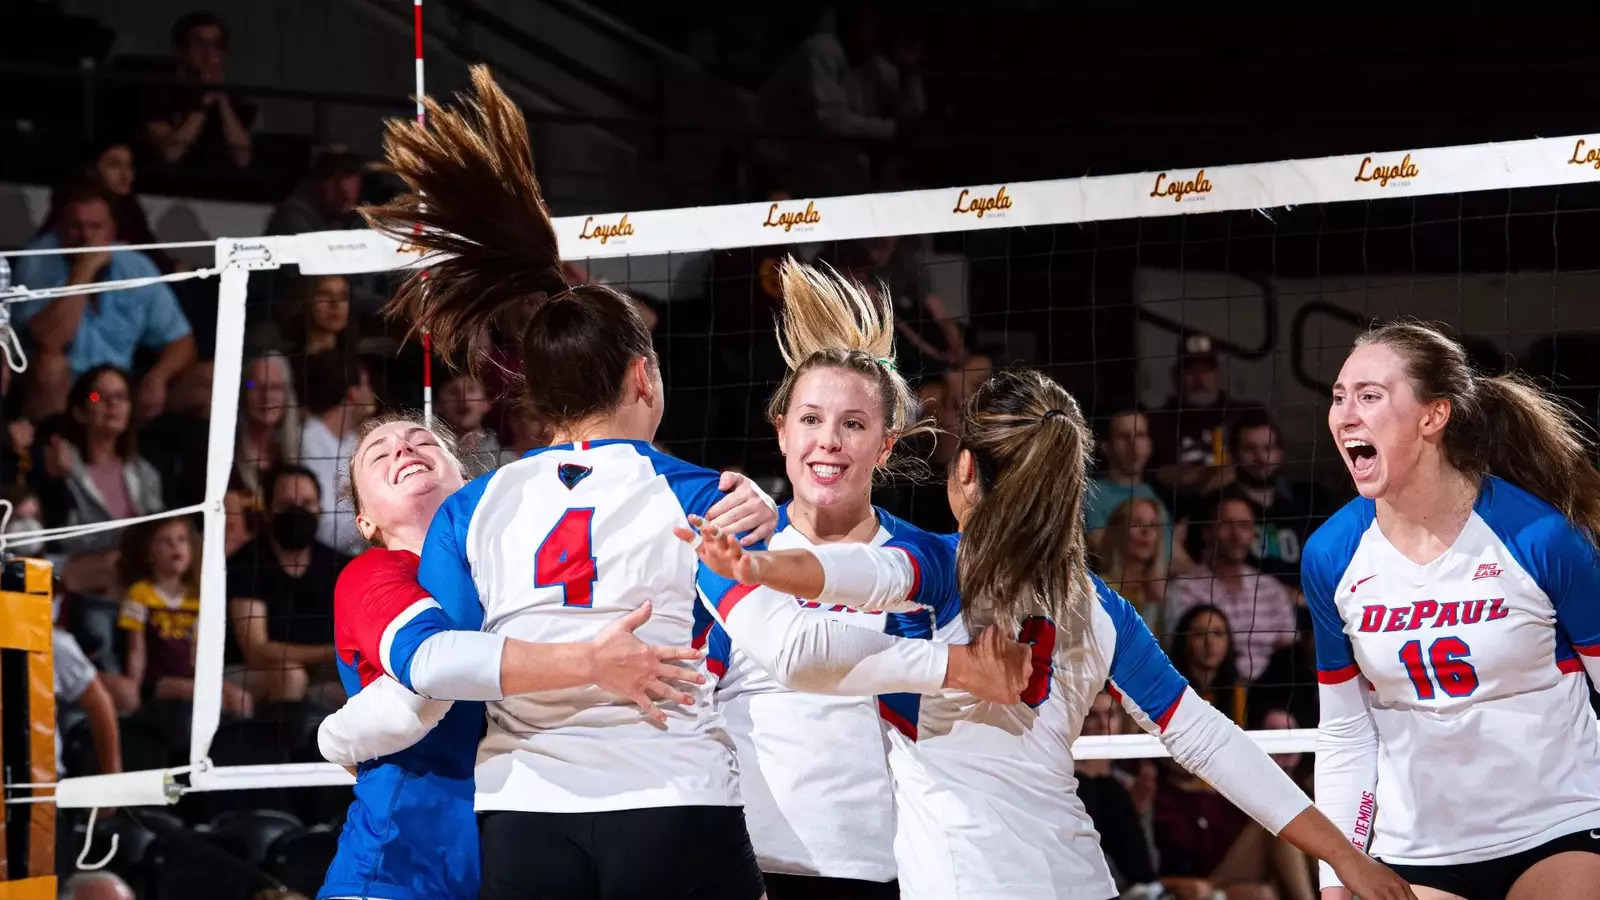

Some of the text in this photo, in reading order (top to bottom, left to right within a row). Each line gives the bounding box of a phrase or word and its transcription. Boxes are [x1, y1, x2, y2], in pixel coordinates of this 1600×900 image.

[1150, 169, 1212, 202] Loyola
[1354, 153, 1419, 188] Loyola
[763, 200, 820, 232] Loyola
[953, 186, 1012, 218] Loyola
[579, 213, 634, 244] Loyola
[534, 506, 598, 608] 4
[1477, 562, 1498, 571] BIG
[1474, 569, 1504, 578] EAST
[1398, 635, 1480, 701] 16
[1354, 790, 1375, 837] DEMONS
